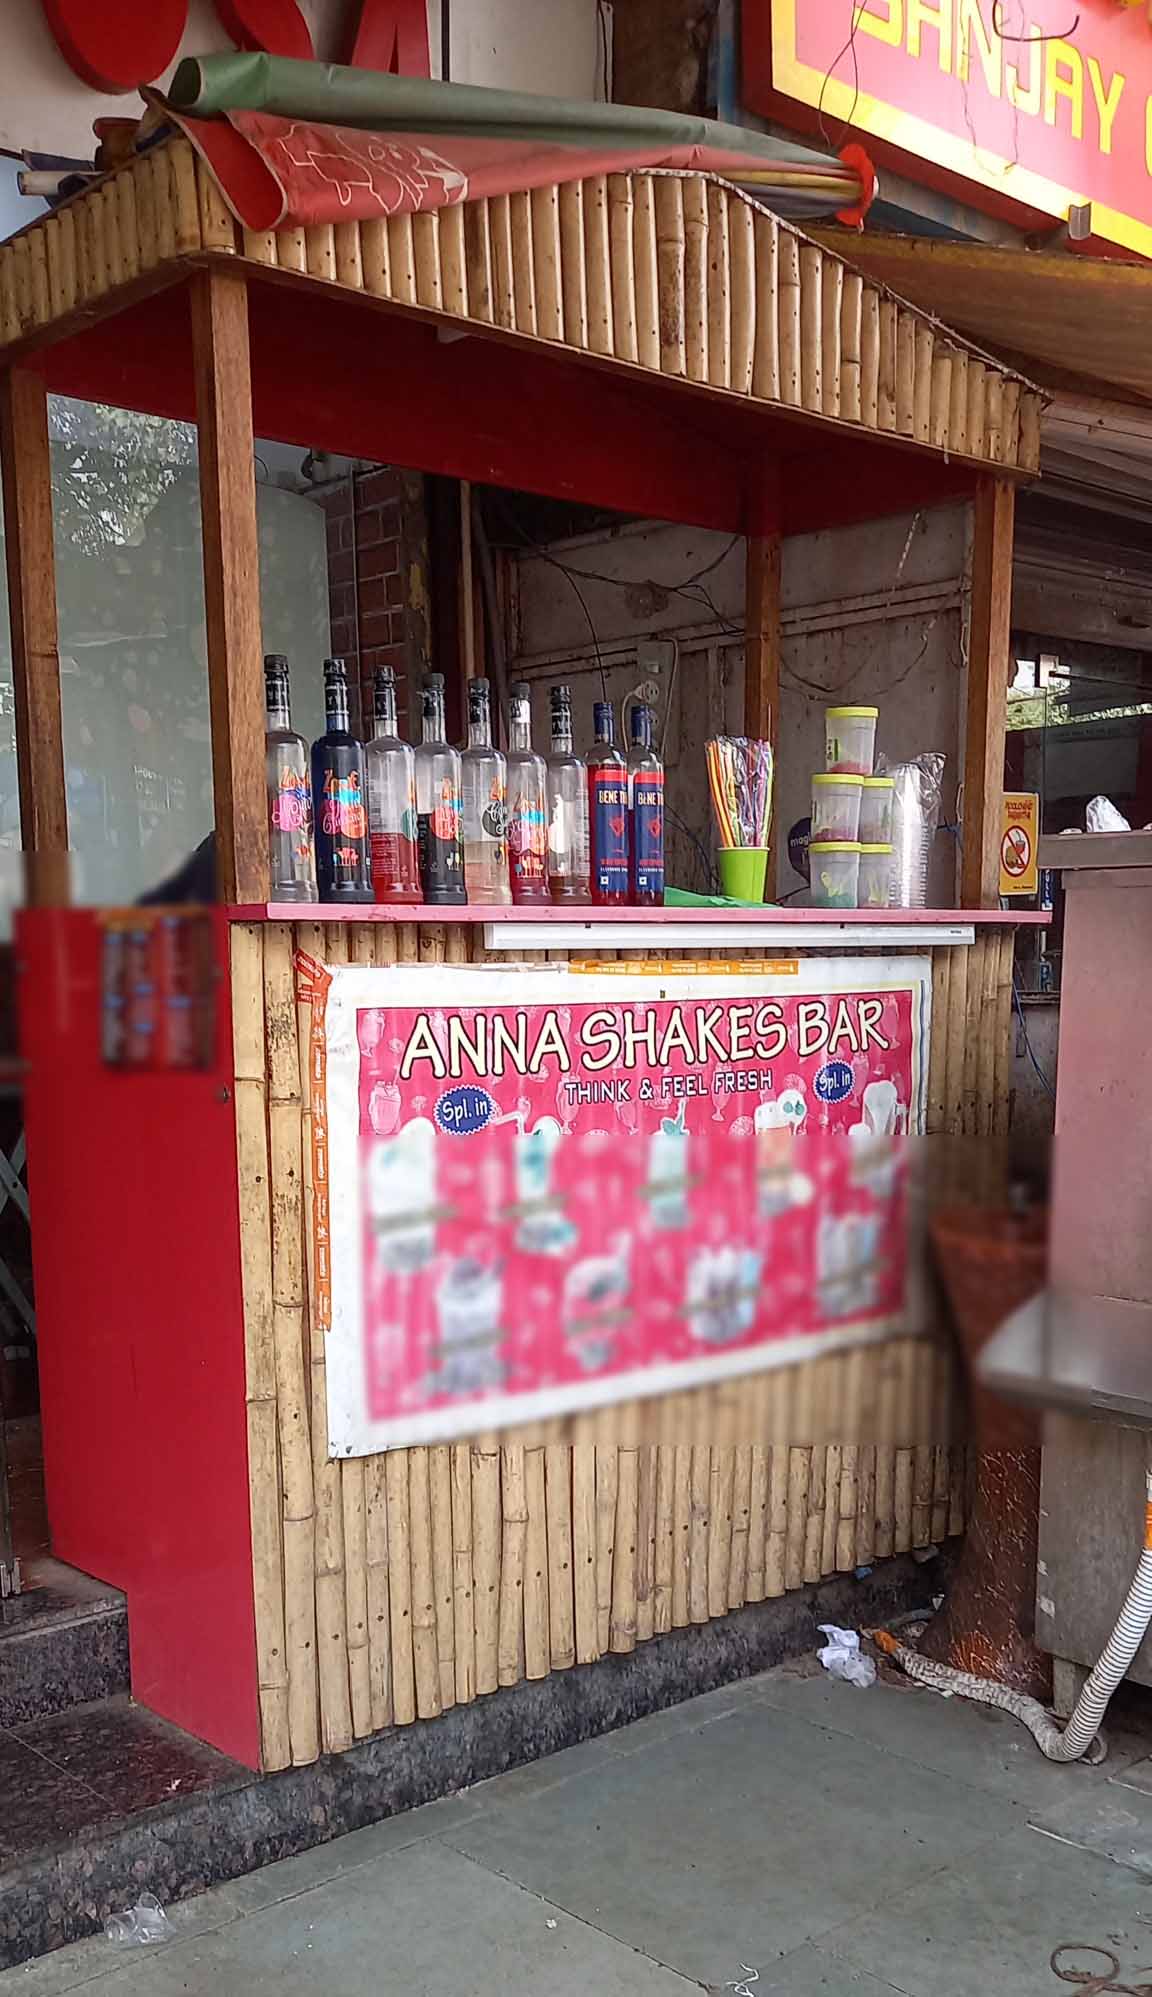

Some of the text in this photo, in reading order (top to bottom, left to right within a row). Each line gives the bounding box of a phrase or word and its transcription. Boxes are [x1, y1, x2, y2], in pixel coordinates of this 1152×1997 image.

[400, 998, 889, 1080] ANNA SHAKES BAR
[565, 1068, 772, 1105] THINK & FEEL FRESH
[841, 1070, 851, 1088] in
[442, 1097, 488, 1127] Spl. in
